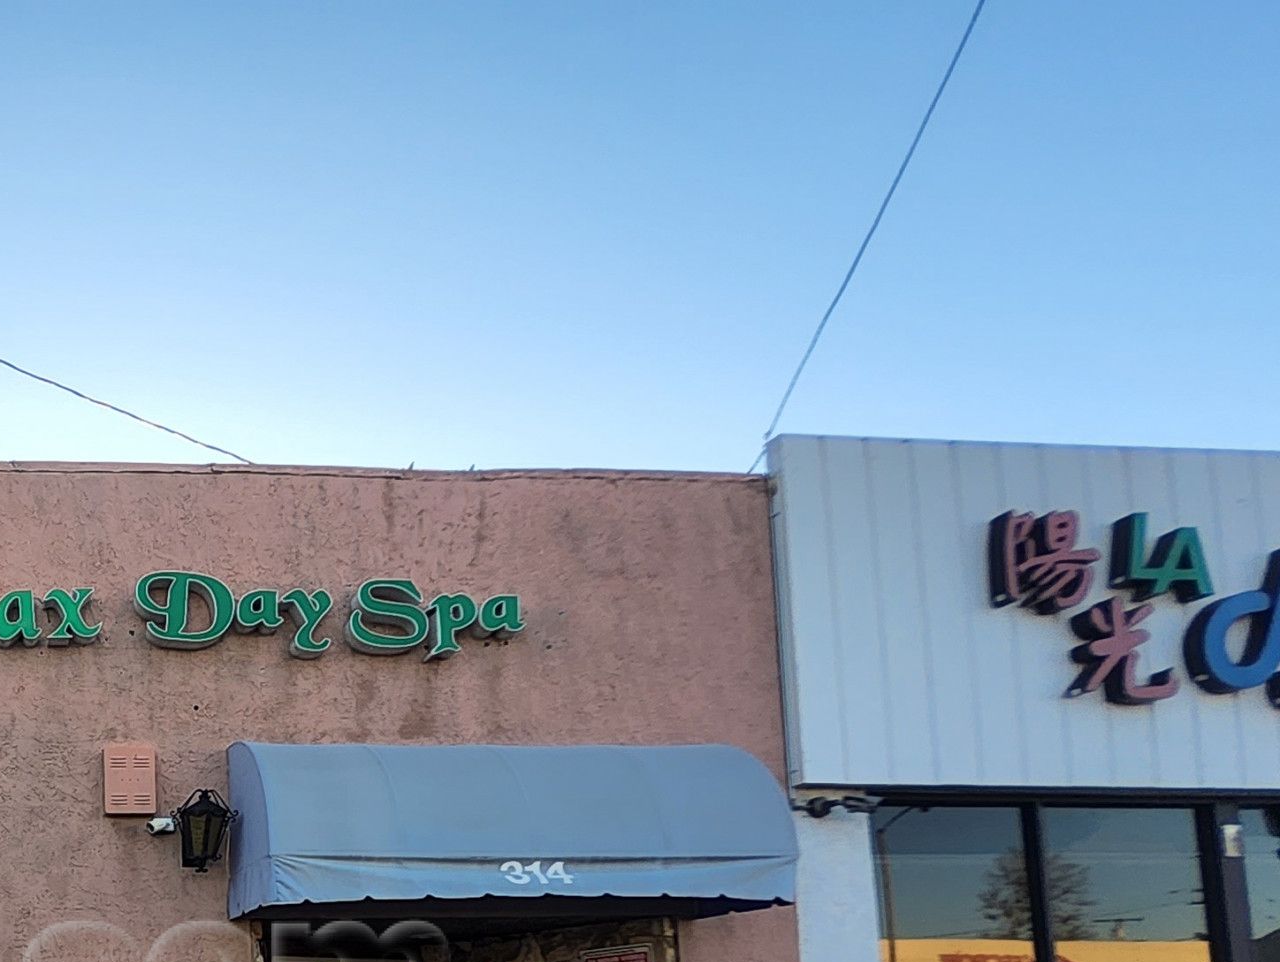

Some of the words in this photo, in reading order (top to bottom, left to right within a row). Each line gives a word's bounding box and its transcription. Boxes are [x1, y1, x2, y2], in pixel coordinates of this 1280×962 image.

[1111, 512, 1214, 602] LA
[134, 570, 332, 657] Day
[347, 578, 526, 660] Spa
[498, 859, 575, 886] 314
